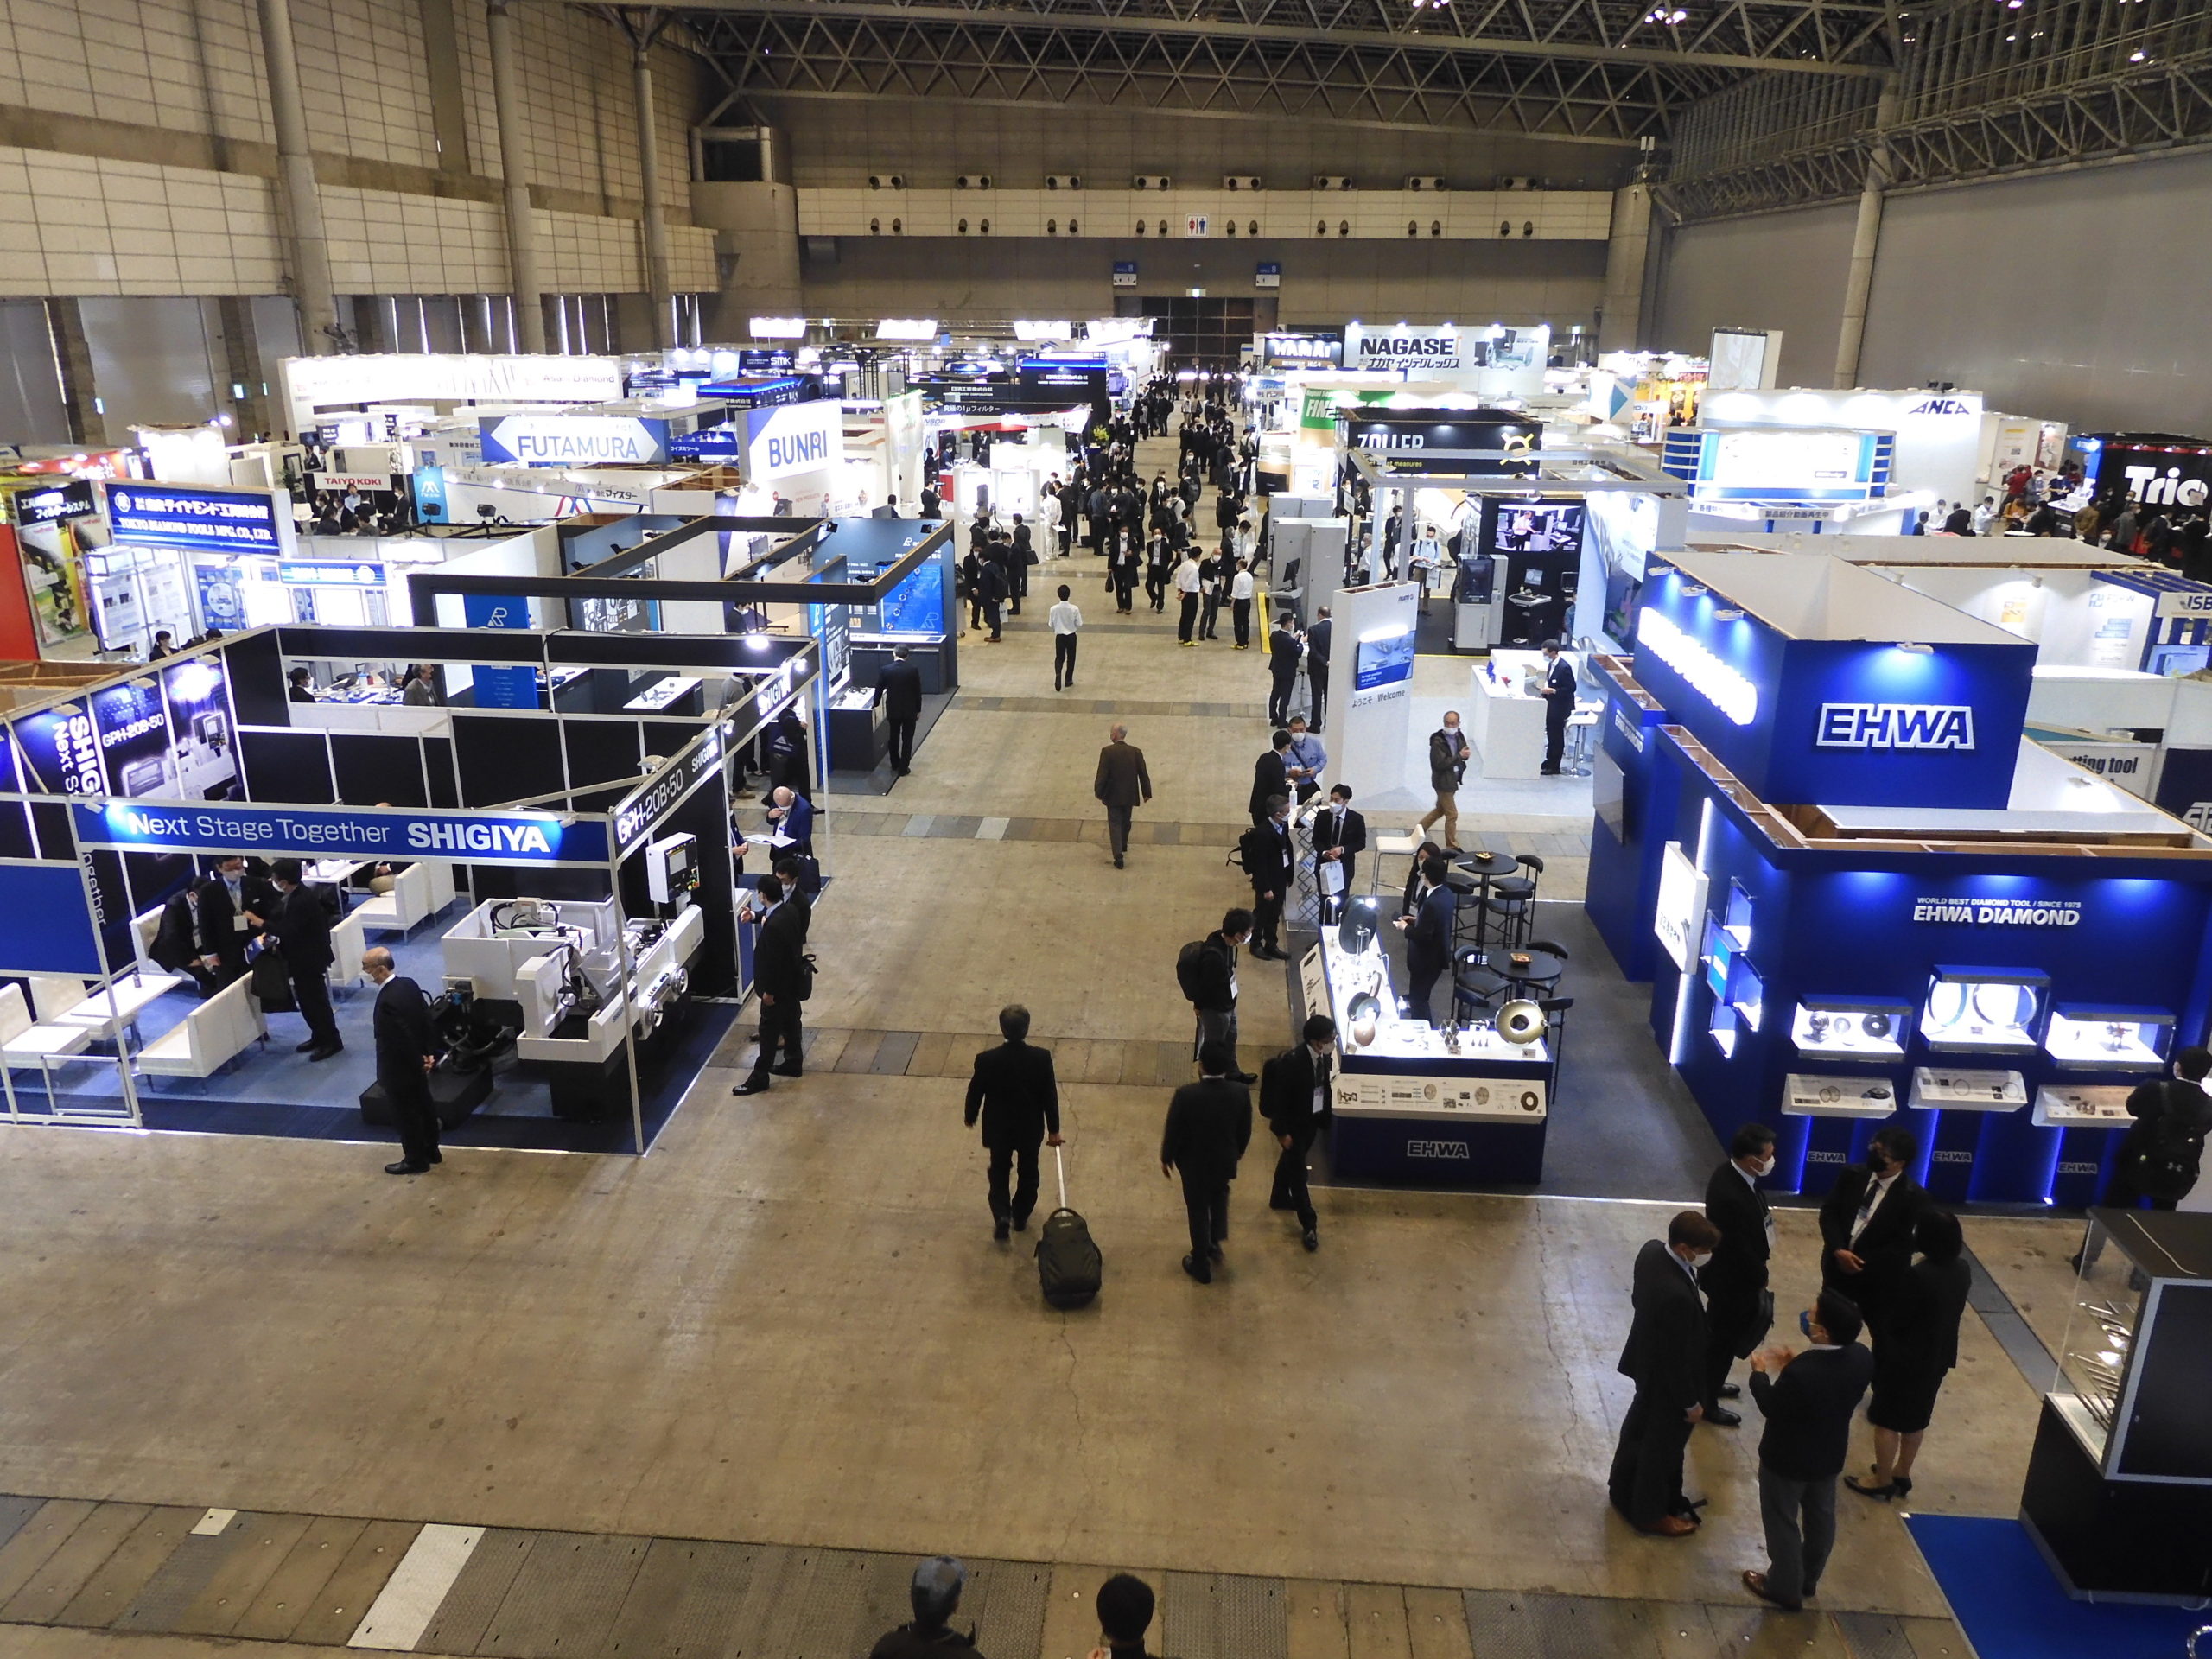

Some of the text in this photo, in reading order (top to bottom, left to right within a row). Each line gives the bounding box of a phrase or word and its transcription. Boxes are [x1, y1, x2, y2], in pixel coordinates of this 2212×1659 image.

[1128, 264, 1134, 272] 8
[1271, 264, 1277, 273] 8
[1908, 399, 1970, 415] ANCA
[517, 435, 640, 460] FUTAMURA
[768, 429, 828, 468] BUNRI
[324, 477, 355, 486] TAIYO
[1351, 690, 1406, 709] ようこそ Welcome
[1816, 702, 1975, 750] EHWA
[51, 721, 73, 773] Next
[69, 715, 104, 796] SHIG
[2108, 756, 2139, 774] tool
[130, 812, 552, 853] Next Stage Together SHIGIYA
[1916, 896, 1948, 905] WORLD
[1913, 905, 2081, 926] EHWA DIAMOND
[1407, 1139, 1470, 1160] EHWA
[1805, 1150, 1846, 1164] EHWA
[1932, 1150, 1973, 1163] EHWA
[2057, 1160, 2098, 1175] EHWA
